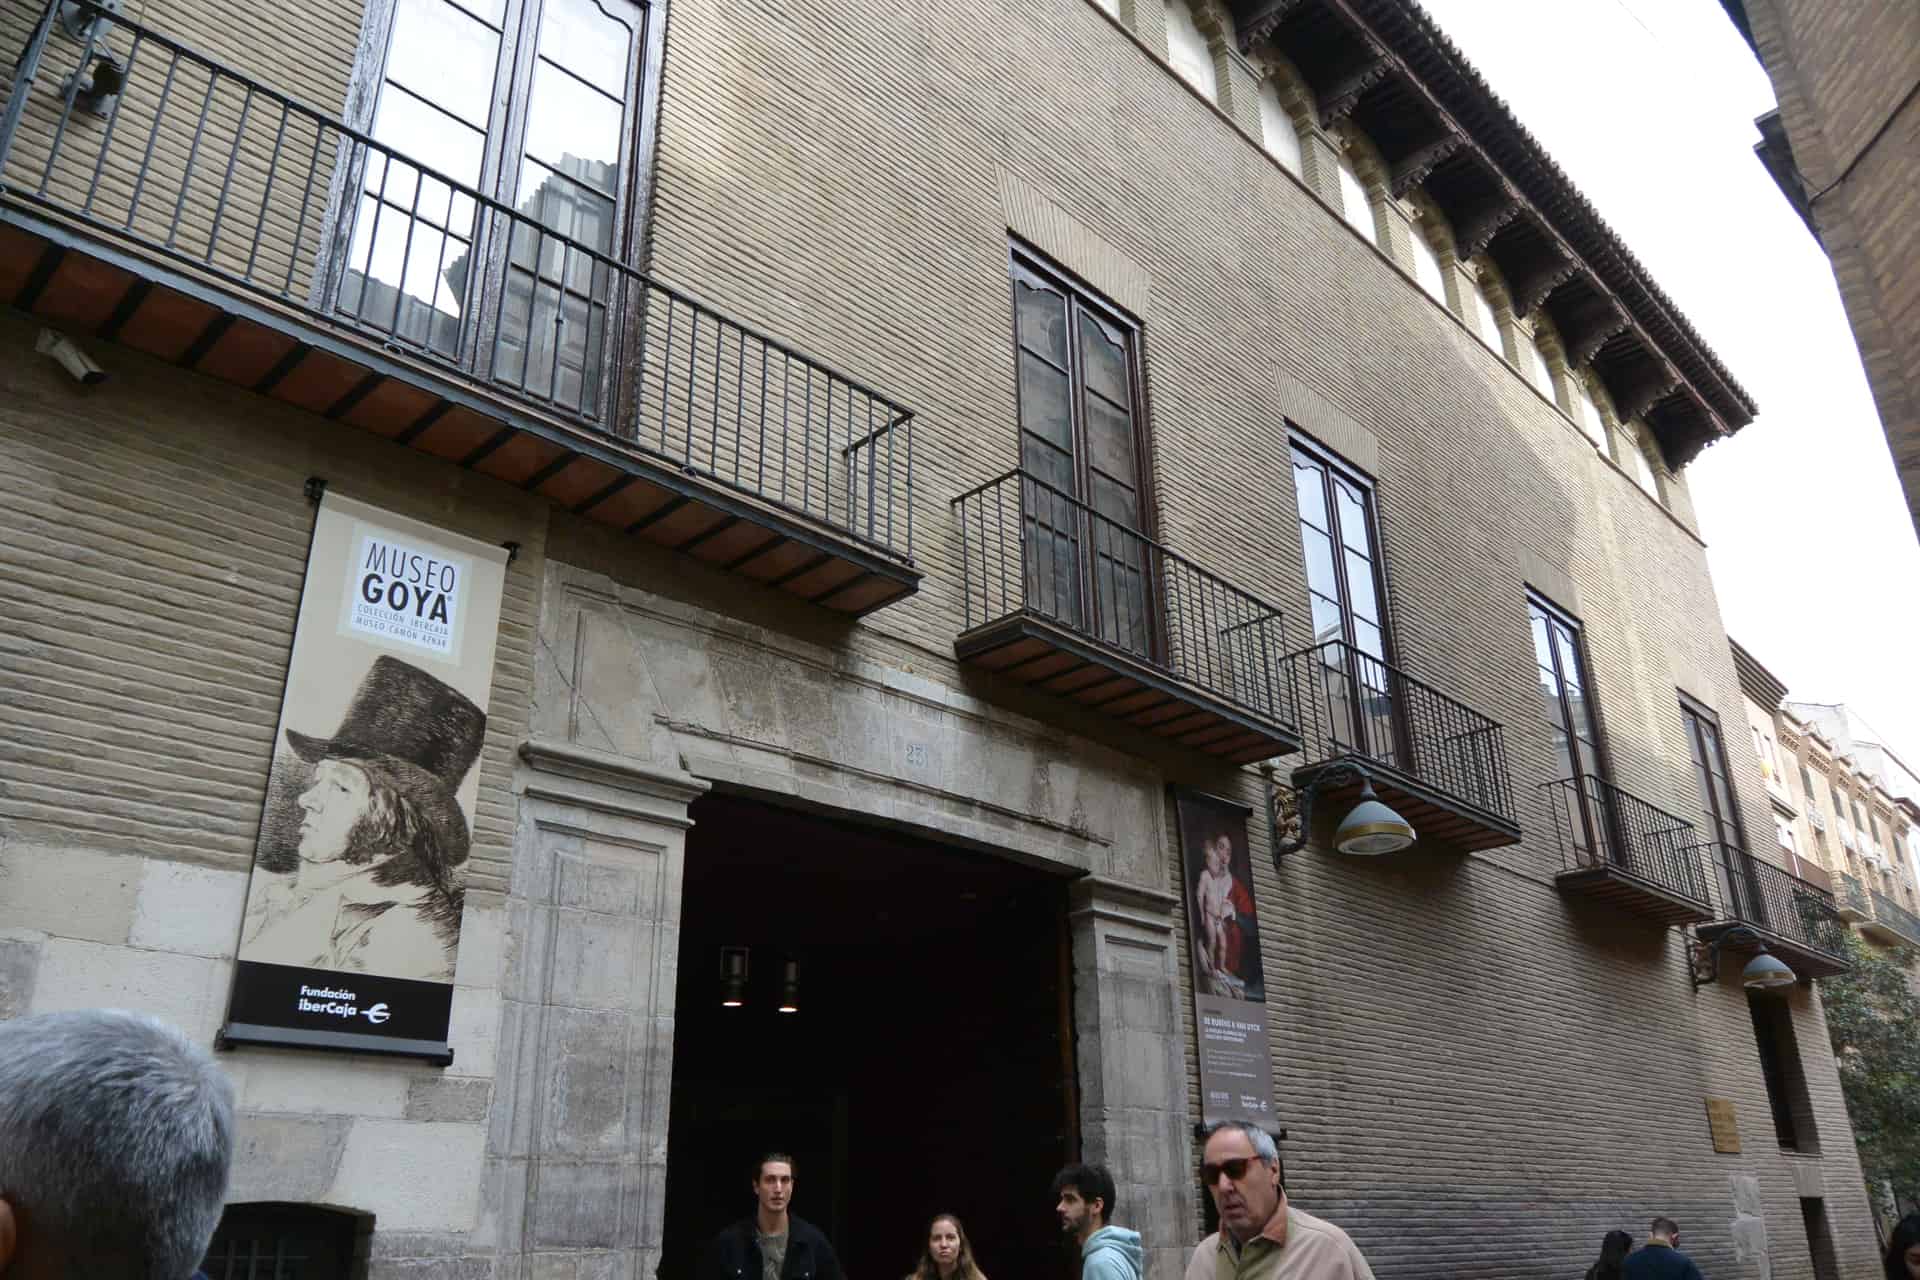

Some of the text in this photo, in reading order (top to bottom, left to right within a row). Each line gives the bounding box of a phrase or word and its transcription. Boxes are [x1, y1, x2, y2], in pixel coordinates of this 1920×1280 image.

[366, 543, 455, 592] MUSEO
[362, 573, 448, 624] GOYA
[356, 616, 385, 630] MUSEO
[300, 985, 356, 1001] Fundación
